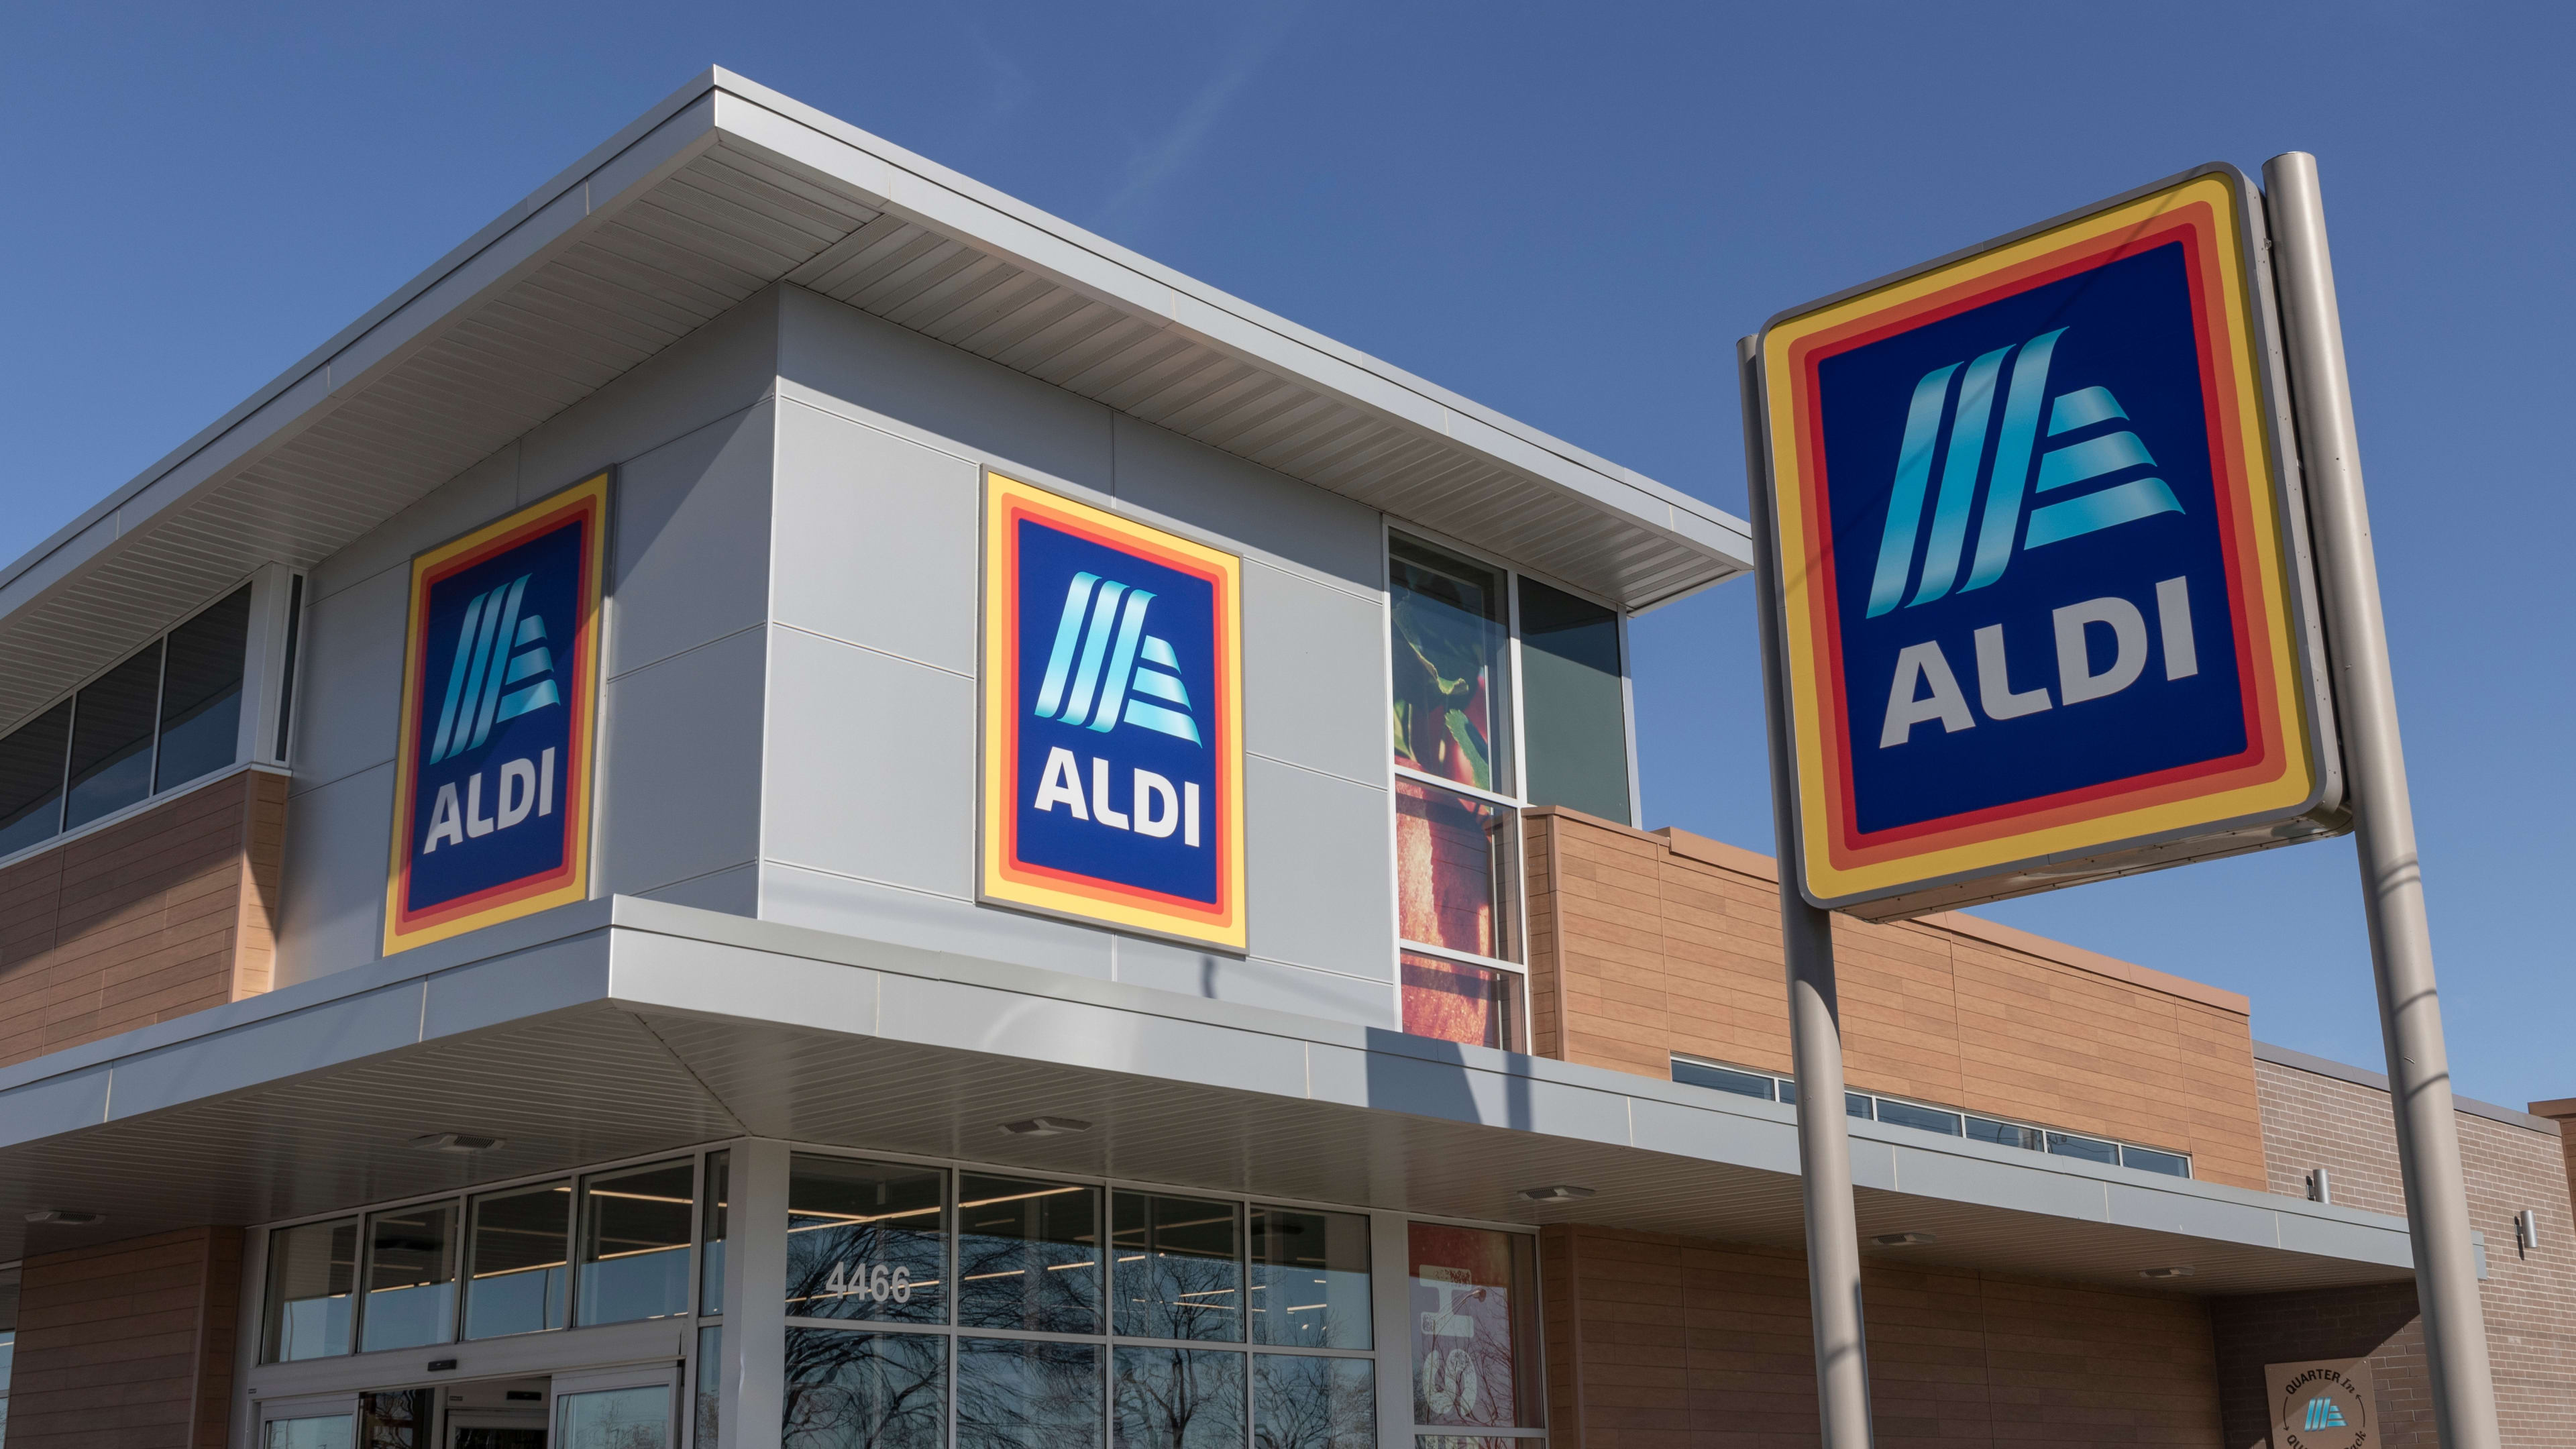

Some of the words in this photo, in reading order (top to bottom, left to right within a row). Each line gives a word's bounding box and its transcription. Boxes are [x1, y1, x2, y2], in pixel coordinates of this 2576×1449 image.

[1879, 576, 2198, 749] ALDI
[423, 747, 555, 855] ALDI
[1034, 746, 1200, 847] ALDI
[825, 1262, 911, 1303] 4466
[2286, 1368, 2341, 1395] QUARTER
[2341, 1378, 2355, 1394] In
[2344, 1430, 2366, 1449] ack
